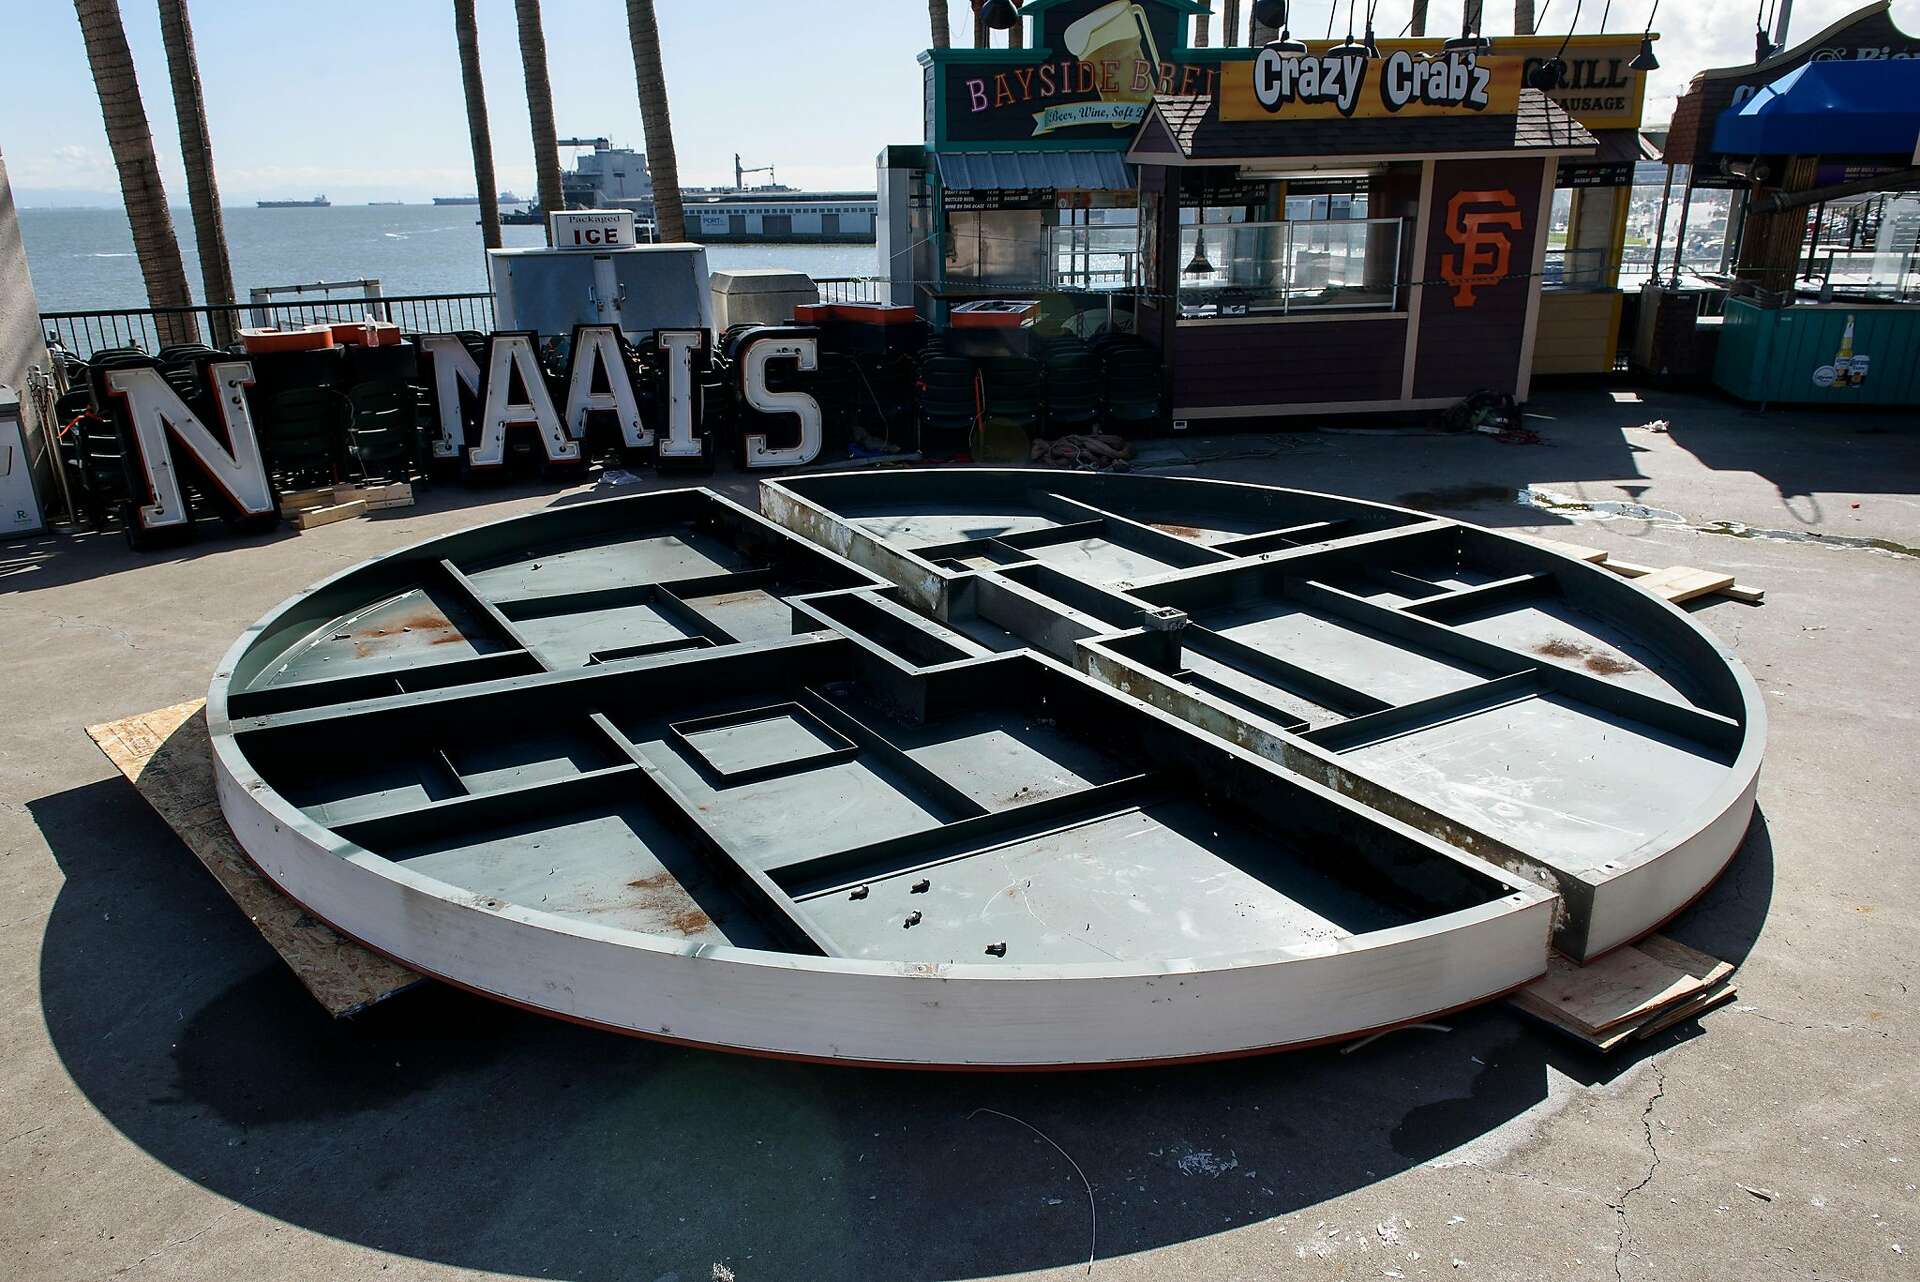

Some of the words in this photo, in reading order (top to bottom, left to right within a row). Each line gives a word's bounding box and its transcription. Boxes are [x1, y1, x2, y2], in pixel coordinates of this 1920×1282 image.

[965, 60, 1120, 113] BAYSIDE
[1254, 48, 1366, 113] Crazy
[1385, 49, 1491, 108] Crab'z
[1552, 97, 1625, 111] AUSAGE
[1049, 110, 1077, 123] Beer,
[1079, 106, 1109, 119] Wine,
[1112, 105, 1133, 120] Soft
[569, 215, 620, 225] Packaged
[574, 227, 618, 245] ICE
